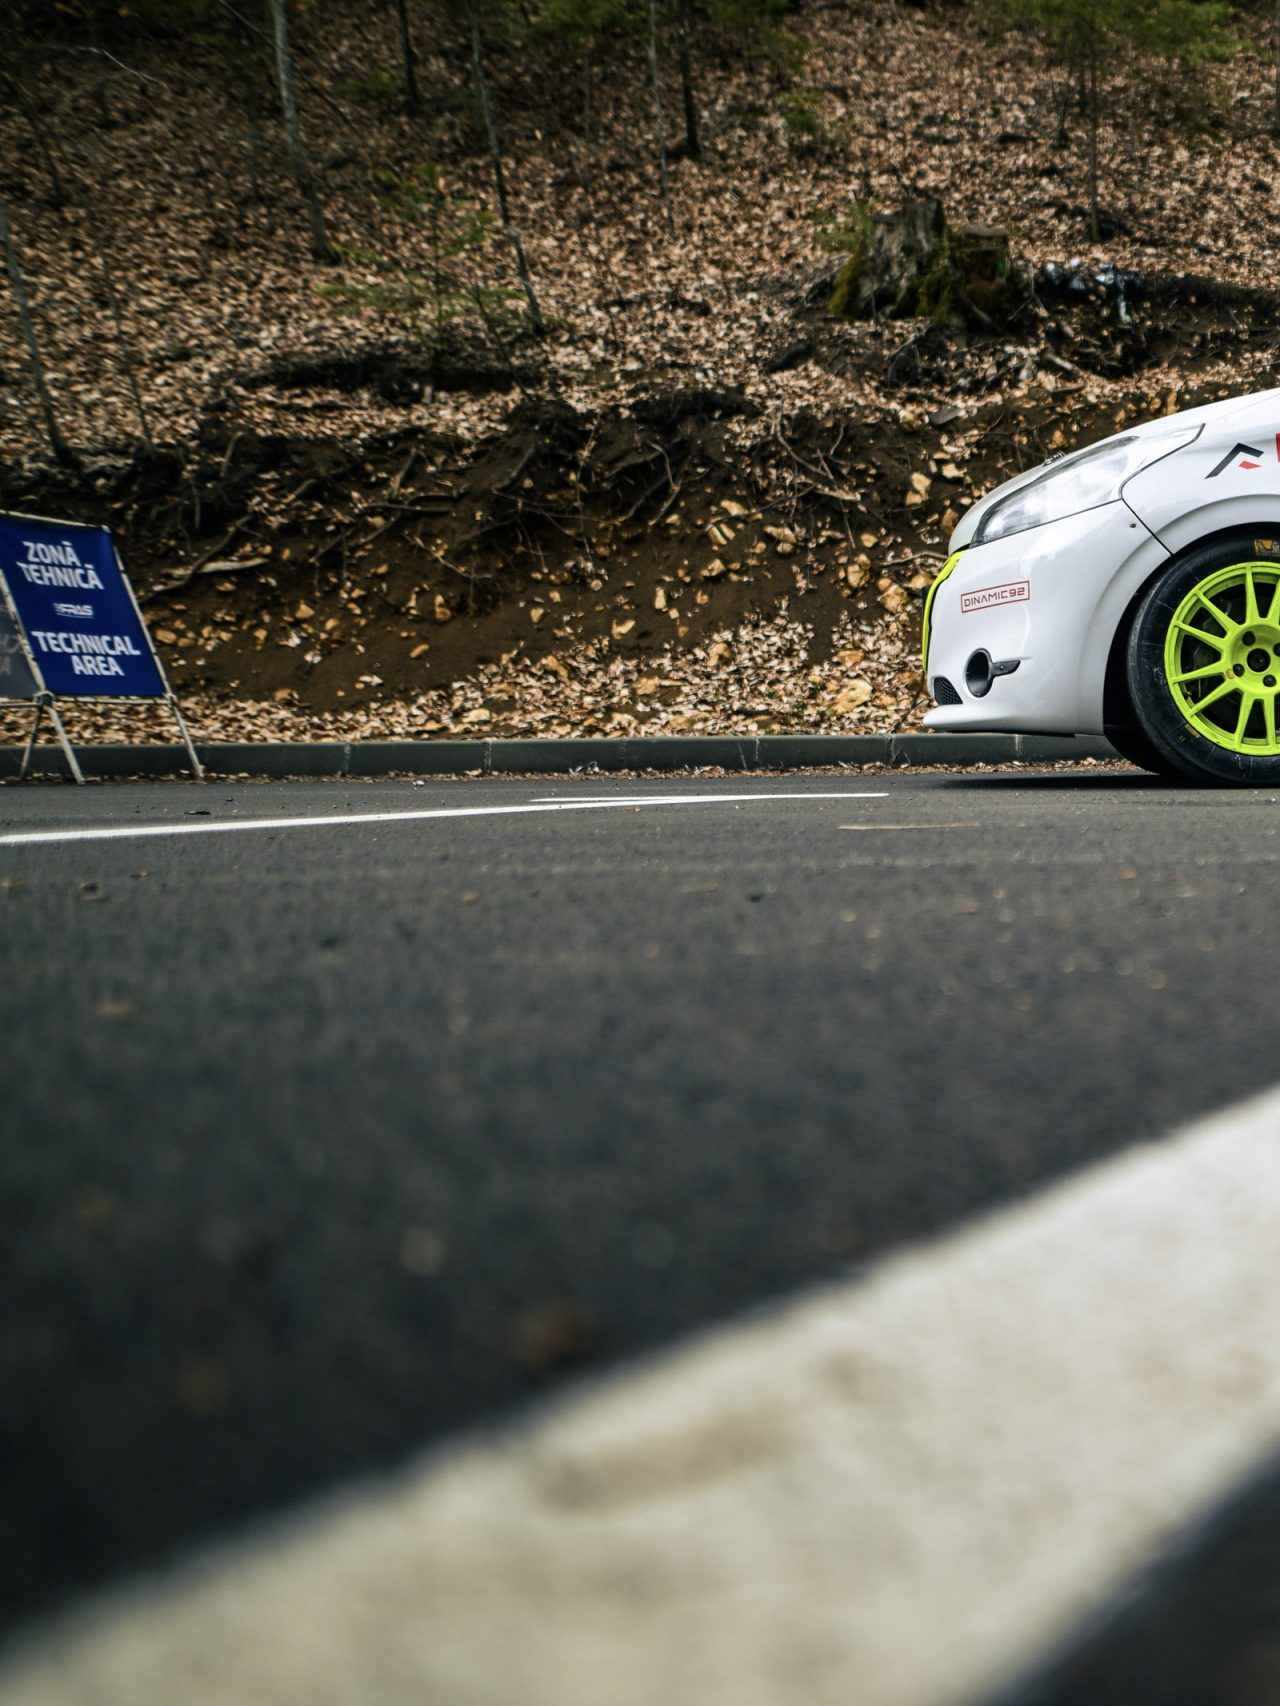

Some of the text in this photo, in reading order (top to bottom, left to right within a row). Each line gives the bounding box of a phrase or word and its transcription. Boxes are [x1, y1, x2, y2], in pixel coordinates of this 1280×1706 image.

[16, 561, 104, 590] TEHNICĂ
[964, 587, 1025, 607] DINAMIC92
[31, 631, 141, 655] TECHNICAL
[71, 655, 125, 676] AREA
